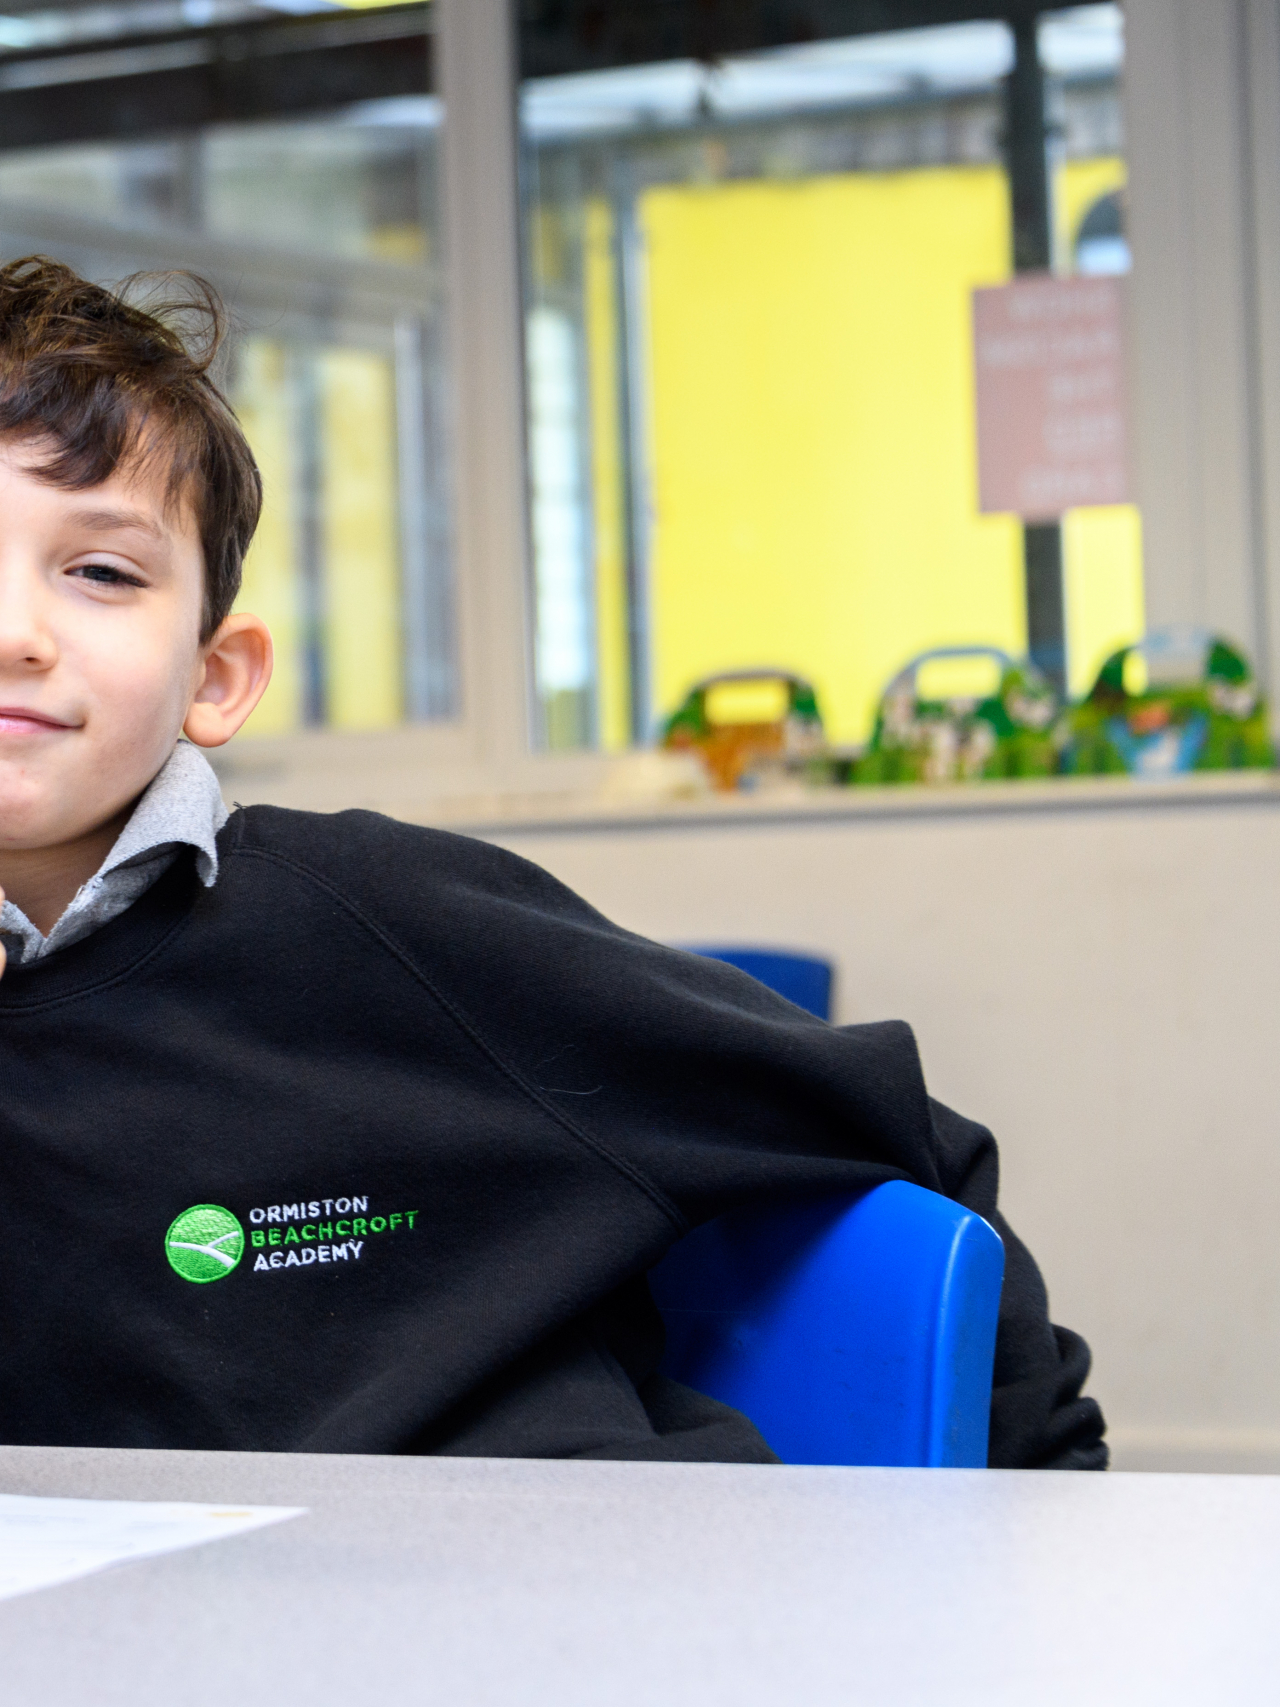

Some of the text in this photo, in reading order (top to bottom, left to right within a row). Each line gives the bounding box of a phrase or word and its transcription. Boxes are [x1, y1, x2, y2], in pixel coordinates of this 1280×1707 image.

[249, 1195, 369, 1224] ORMISTON
[250, 1210, 419, 1248] BEACHCROFT
[253, 1239, 364, 1272] ACADEMY
